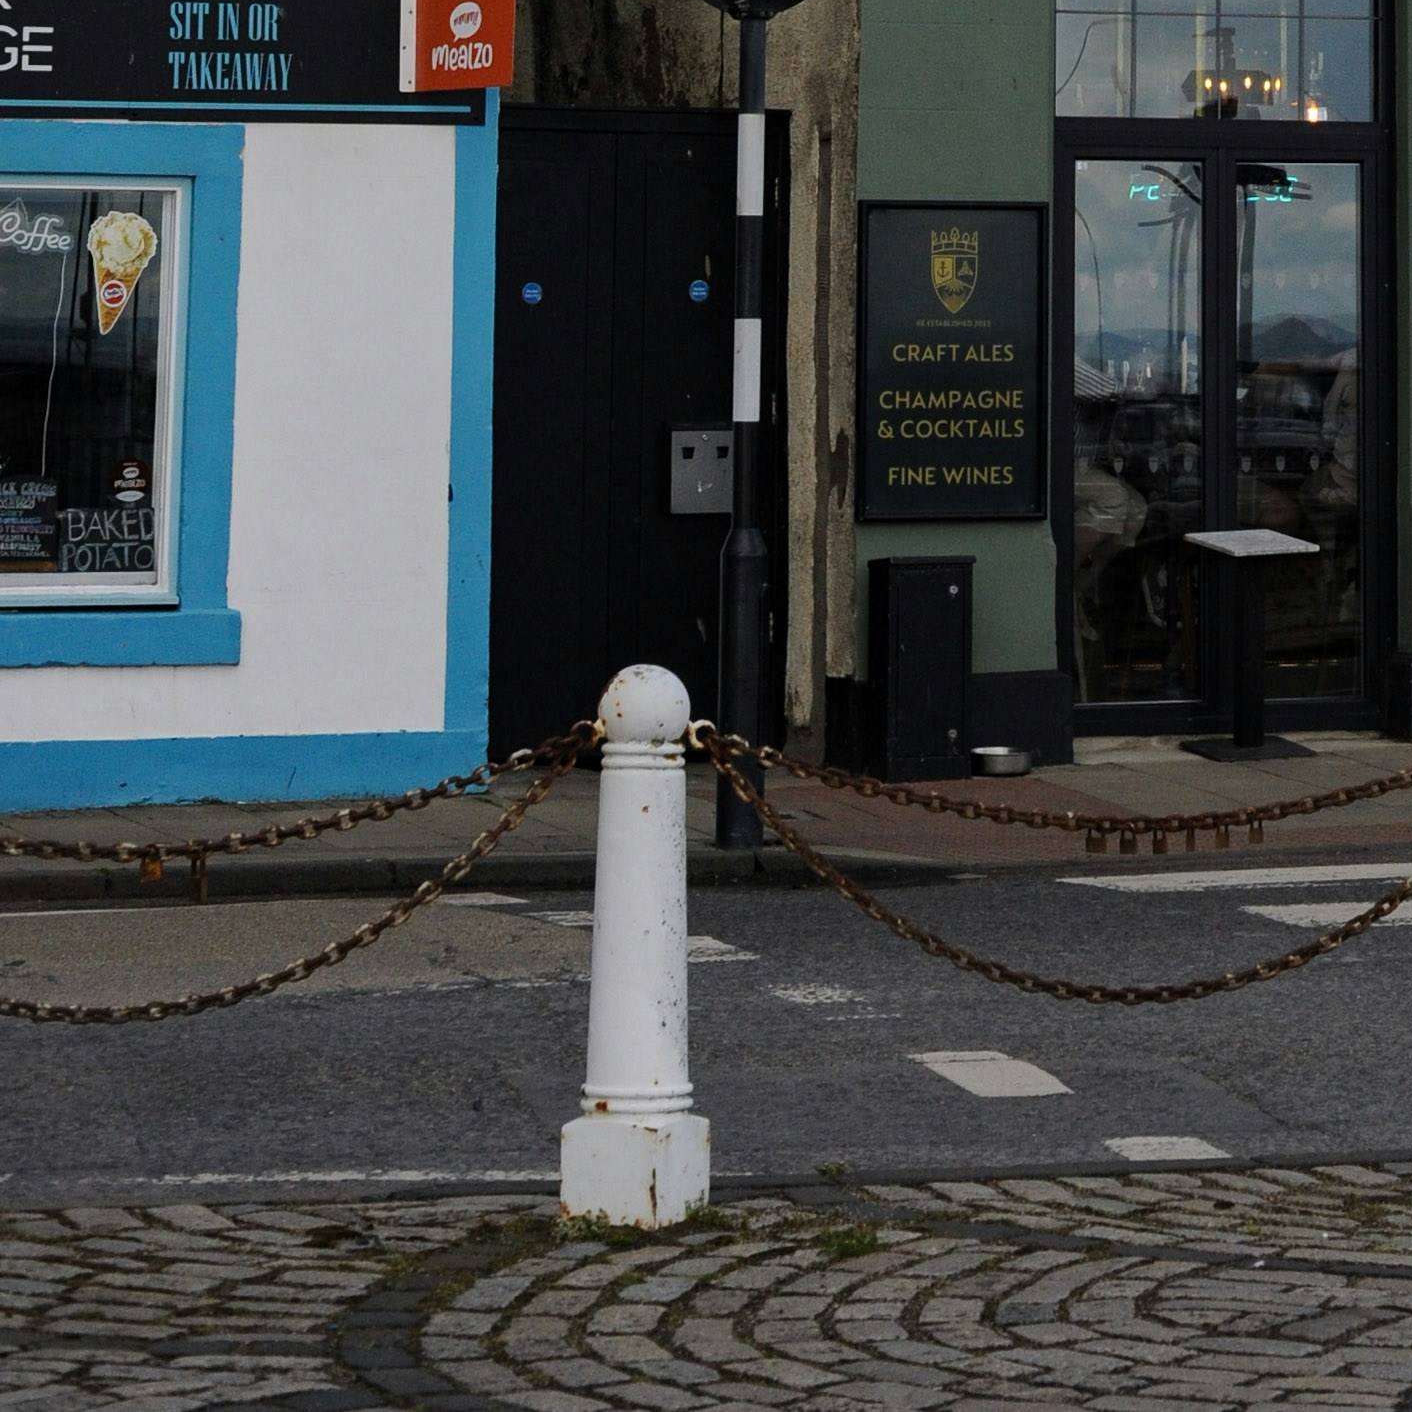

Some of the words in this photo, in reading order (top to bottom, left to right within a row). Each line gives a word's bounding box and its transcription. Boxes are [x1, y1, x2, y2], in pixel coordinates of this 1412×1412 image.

[169, 2, 210, 40] SIT
[217, 3, 240, 41] IN
[248, 3, 279, 42] OR
[168, 51, 293, 92] TAKEAWAY
[0, 212, 71, 251] Coffee
[893, 344, 960, 362] CRAFT
[965, 344, 1014, 362] ALES
[879, 390, 1024, 409] CHAMPAGNE
[877, 420, 894, 439] &
[900, 419, 1025, 439] COCKTAILS
[888, 466, 936, 486] FINE
[942, 466, 1013, 485] WINES
[66, 508, 154, 542] BAKED
[61, 542, 154, 571] POTATO
